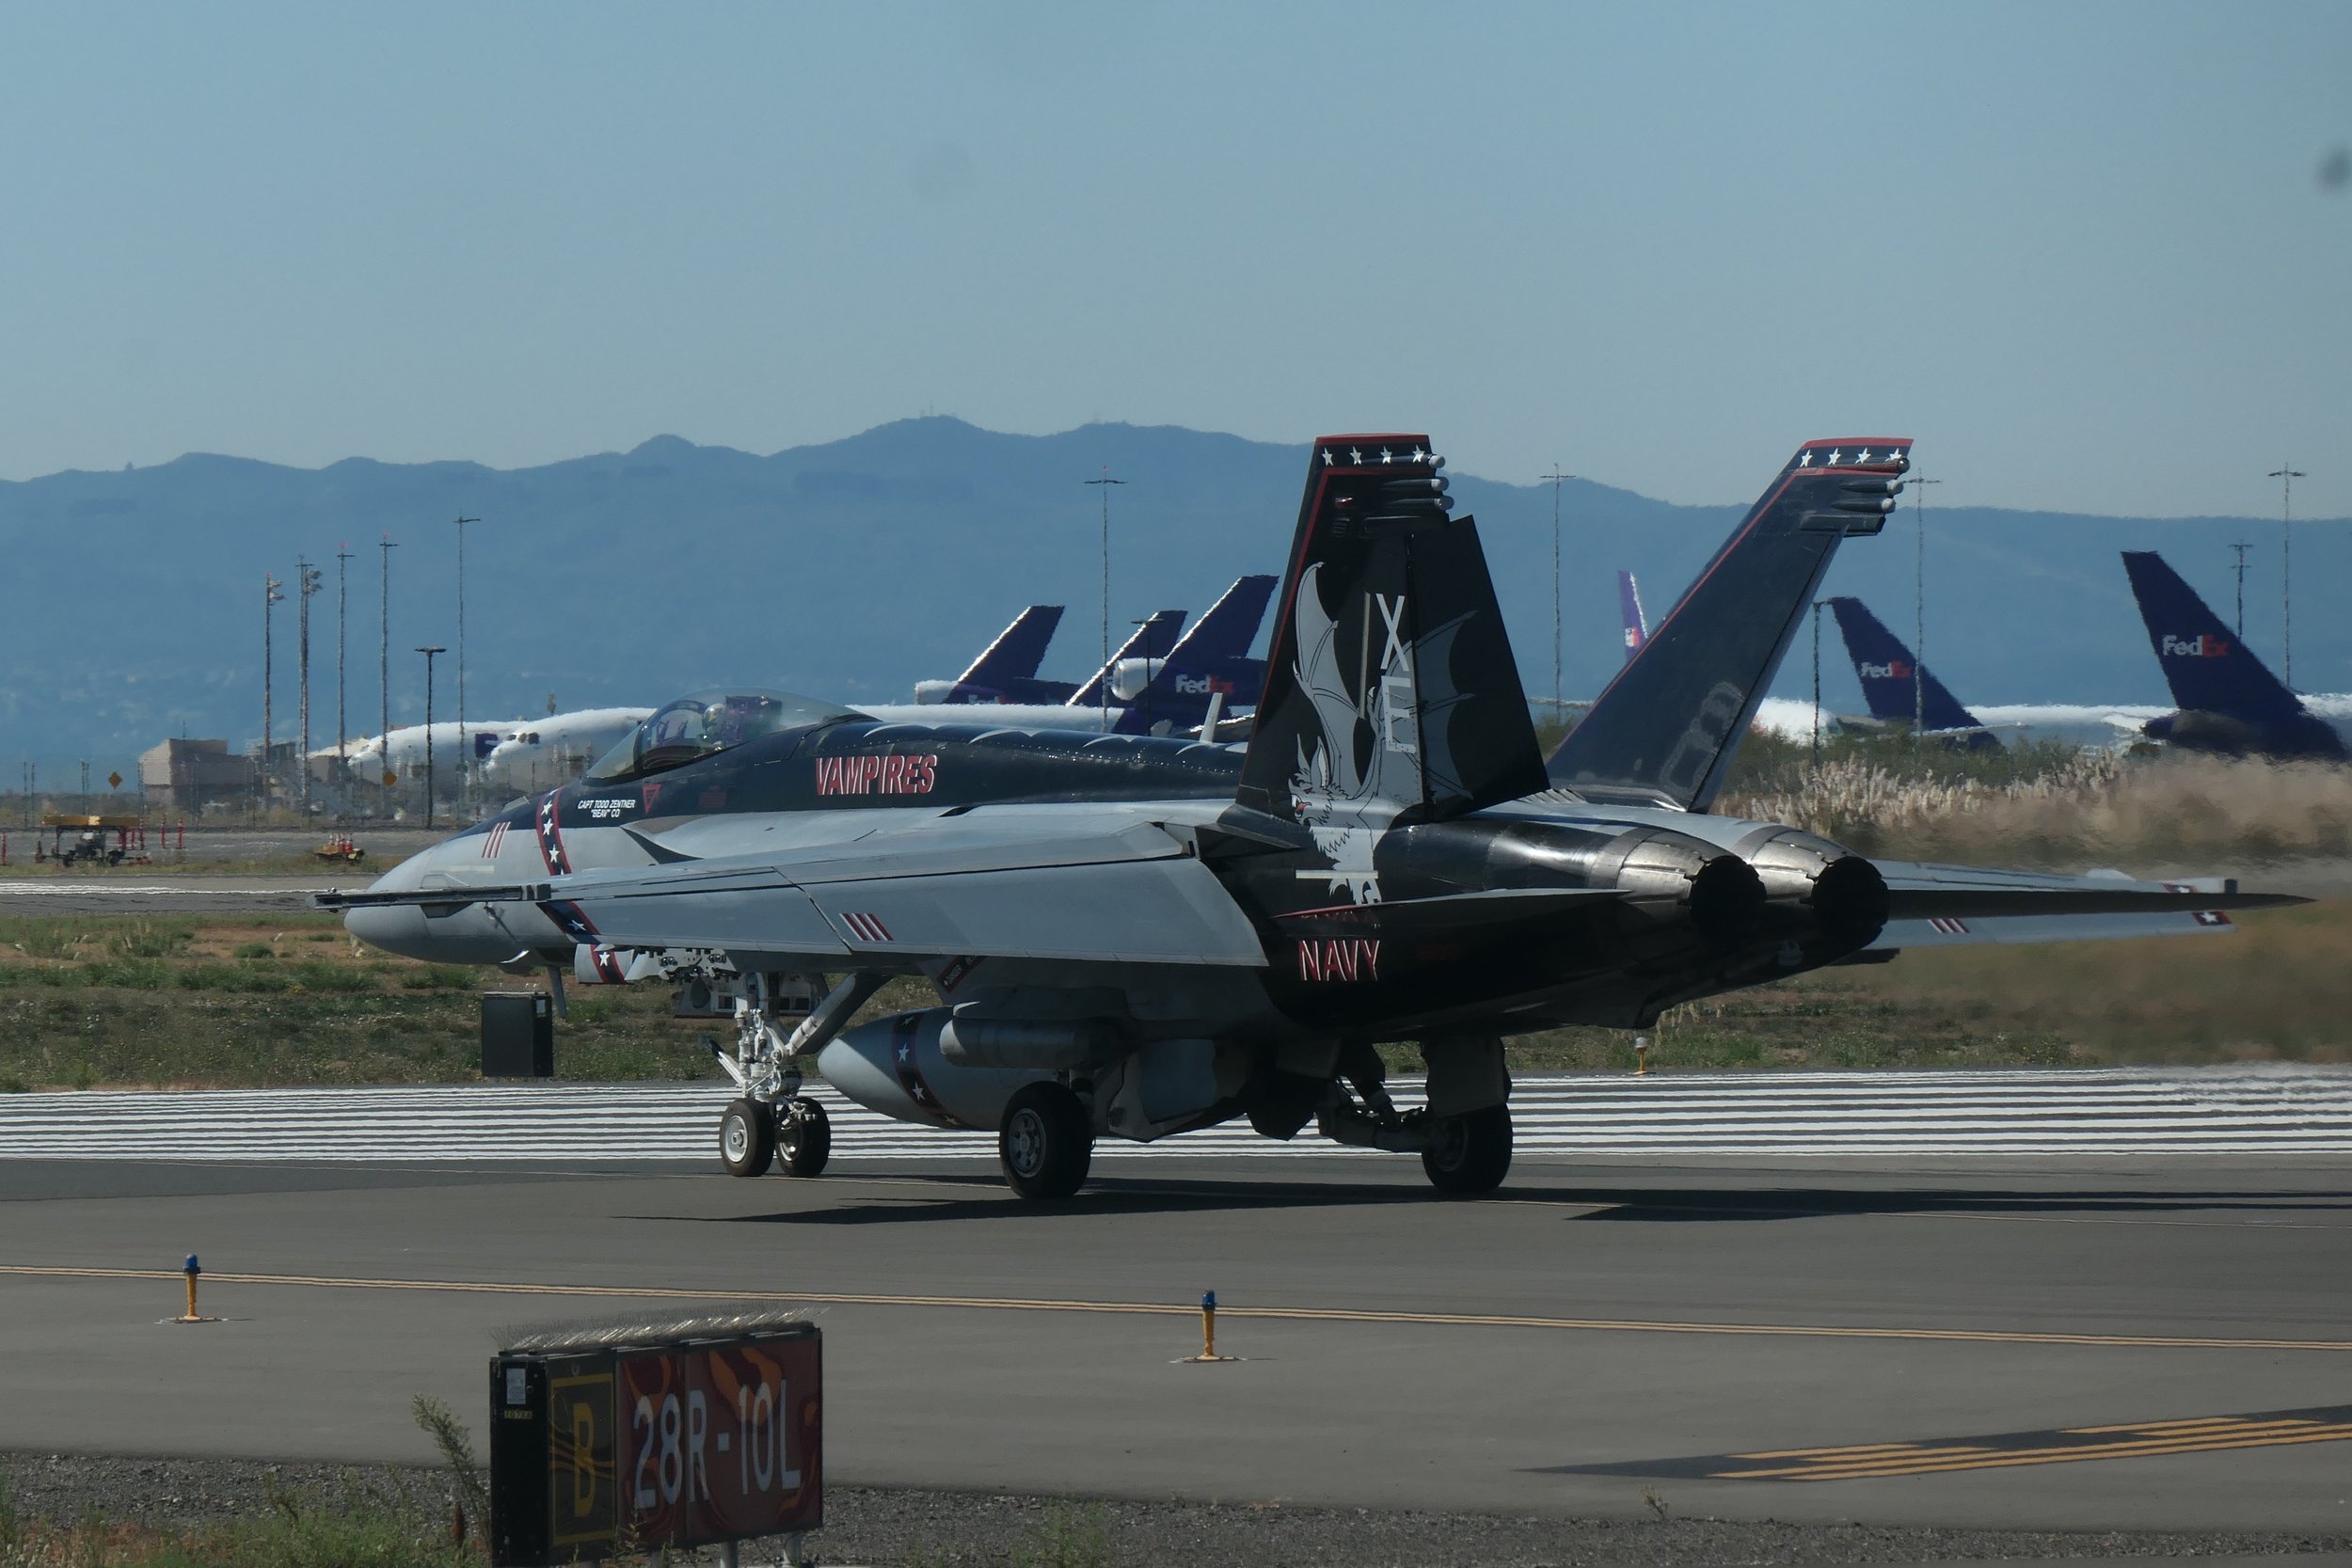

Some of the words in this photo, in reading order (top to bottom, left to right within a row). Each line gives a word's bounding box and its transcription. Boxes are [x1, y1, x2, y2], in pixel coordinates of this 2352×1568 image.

[2163, 635, 2228, 657] FedEx
[1861, 661, 1911, 678] FedEx
[1175, 674, 1234, 693] FedEx
[815, 755, 937, 795] VAMPIRES
[577, 800, 595, 809] CAPT
[594, 800, 610, 808] TODD
[611, 809, 620, 817] CO
[1298, 940, 1379, 981] NAVY
[574, 1402, 596, 1517] B
[633, 1379, 801, 1509] 28R-10L
